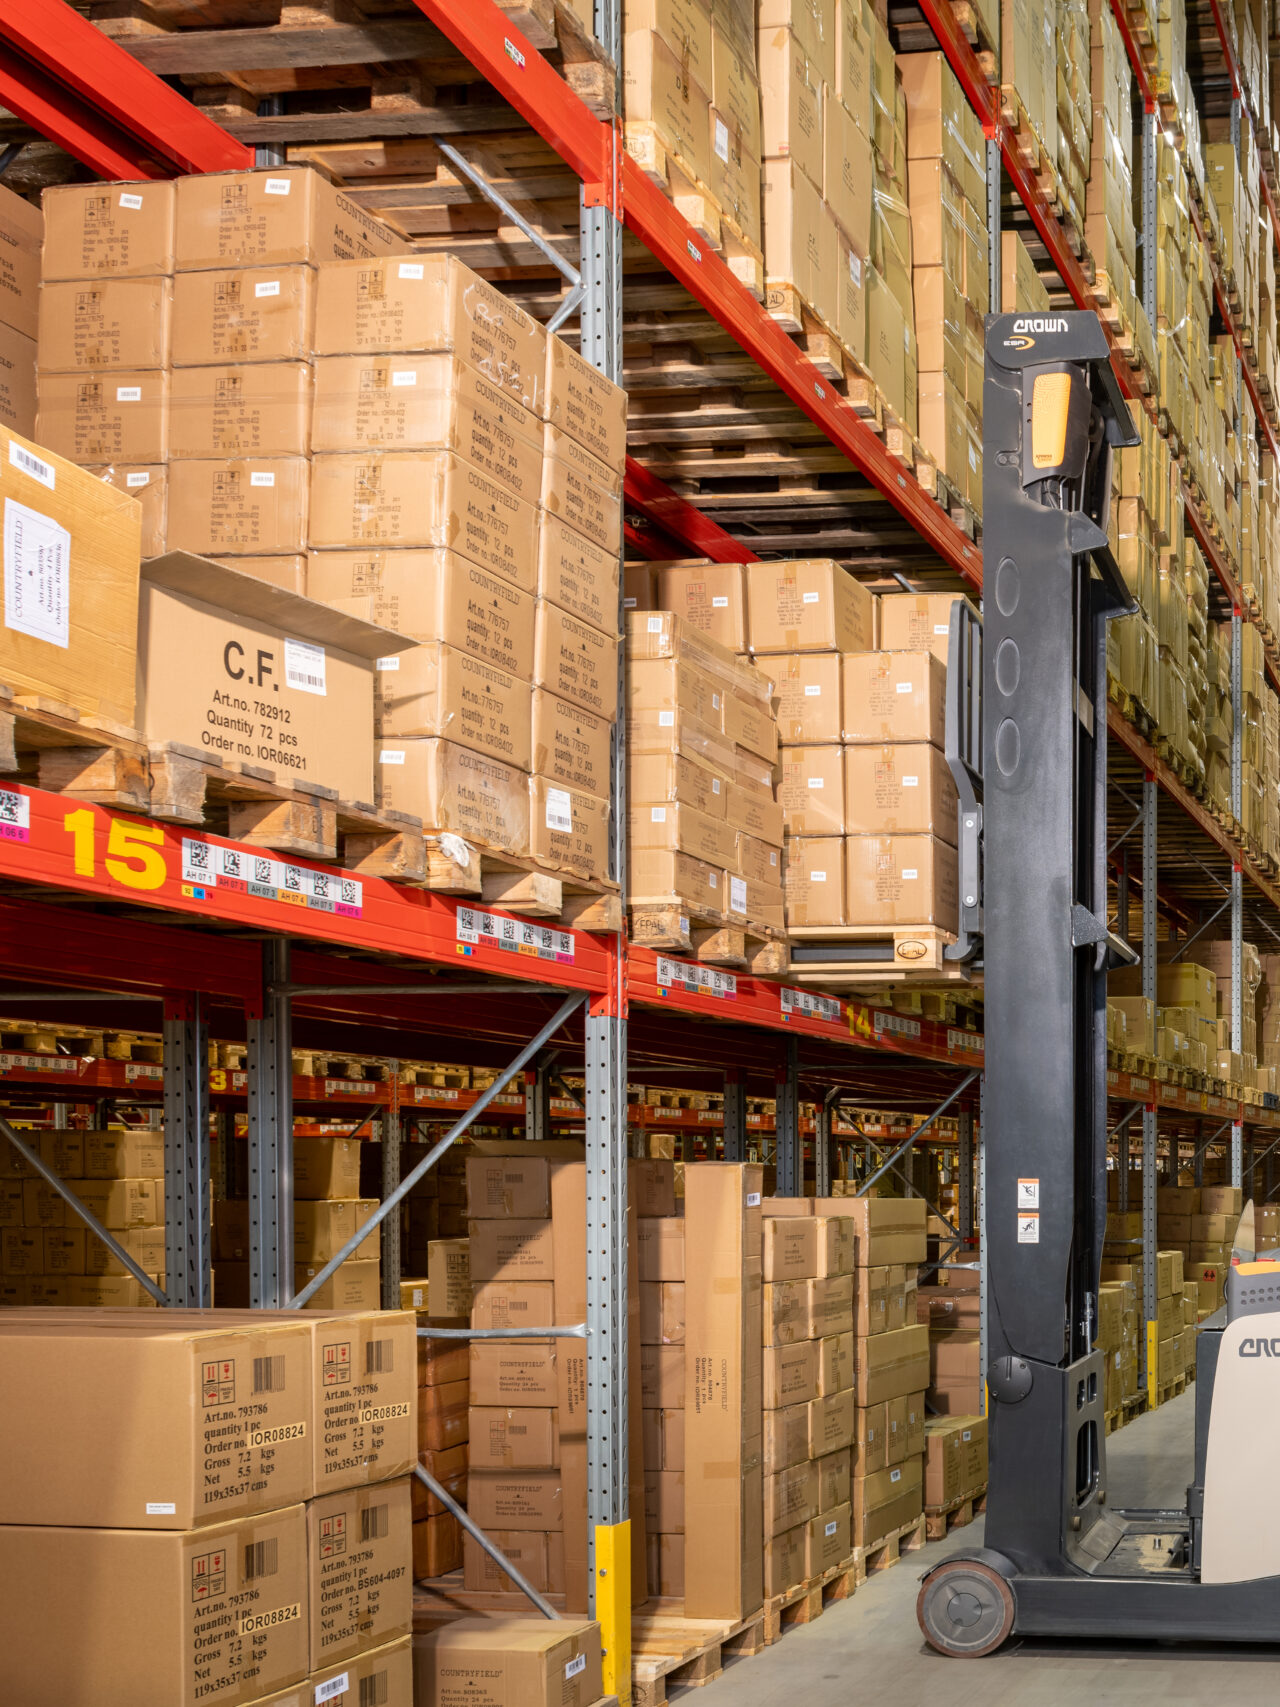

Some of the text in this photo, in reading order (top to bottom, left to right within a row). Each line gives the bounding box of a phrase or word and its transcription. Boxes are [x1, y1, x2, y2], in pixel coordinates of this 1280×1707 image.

[1013, 319, 1069, 333] CROWN
[224, 640, 279, 692] C.F.
[213, 689, 291, 724] Art.no. 782912
[206, 709, 298, 747] Quantity 72 pcs
[201, 730, 307, 771] Order no. IOR06621
[64, 808, 167, 890] 15
[186, 870, 196, 878] AH
[197, 872, 207, 880] 07
[251, 886, 261, 894] AH
[262, 887, 270, 896] 07
[310, 898, 319, 907] AH
[320, 900, 328, 908] 07
[846, 1004, 871, 1039] 14
[353, 1383, 378, 1397] 793786
[204, 1403, 268, 1424] Art.no. 793786
[361, 1404, 408, 1422] IOR08824
[204, 1421, 261, 1441] quantity 1 pc
[204, 1424, 304, 1455] Order no. IOR08824
[204, 1448, 275, 1470] Gross 7.2 kgs
[204, 1463, 275, 1486] Net 5.5 kgs
[204, 1480, 268, 1504] 119x35x37 cms
[320, 1549, 374, 1574] Art.no. 793786
[320, 1571, 352, 1590] quantity
[321, 1567, 406, 1603] Order no. BS604-4097
[194, 1589, 260, 1619] Art.no. 793786
[194, 1614, 232, 1636] quantity
[194, 1606, 298, 1650] Order no. IOR08824
[194, 1666, 261, 1699] 119x35x37 cms
